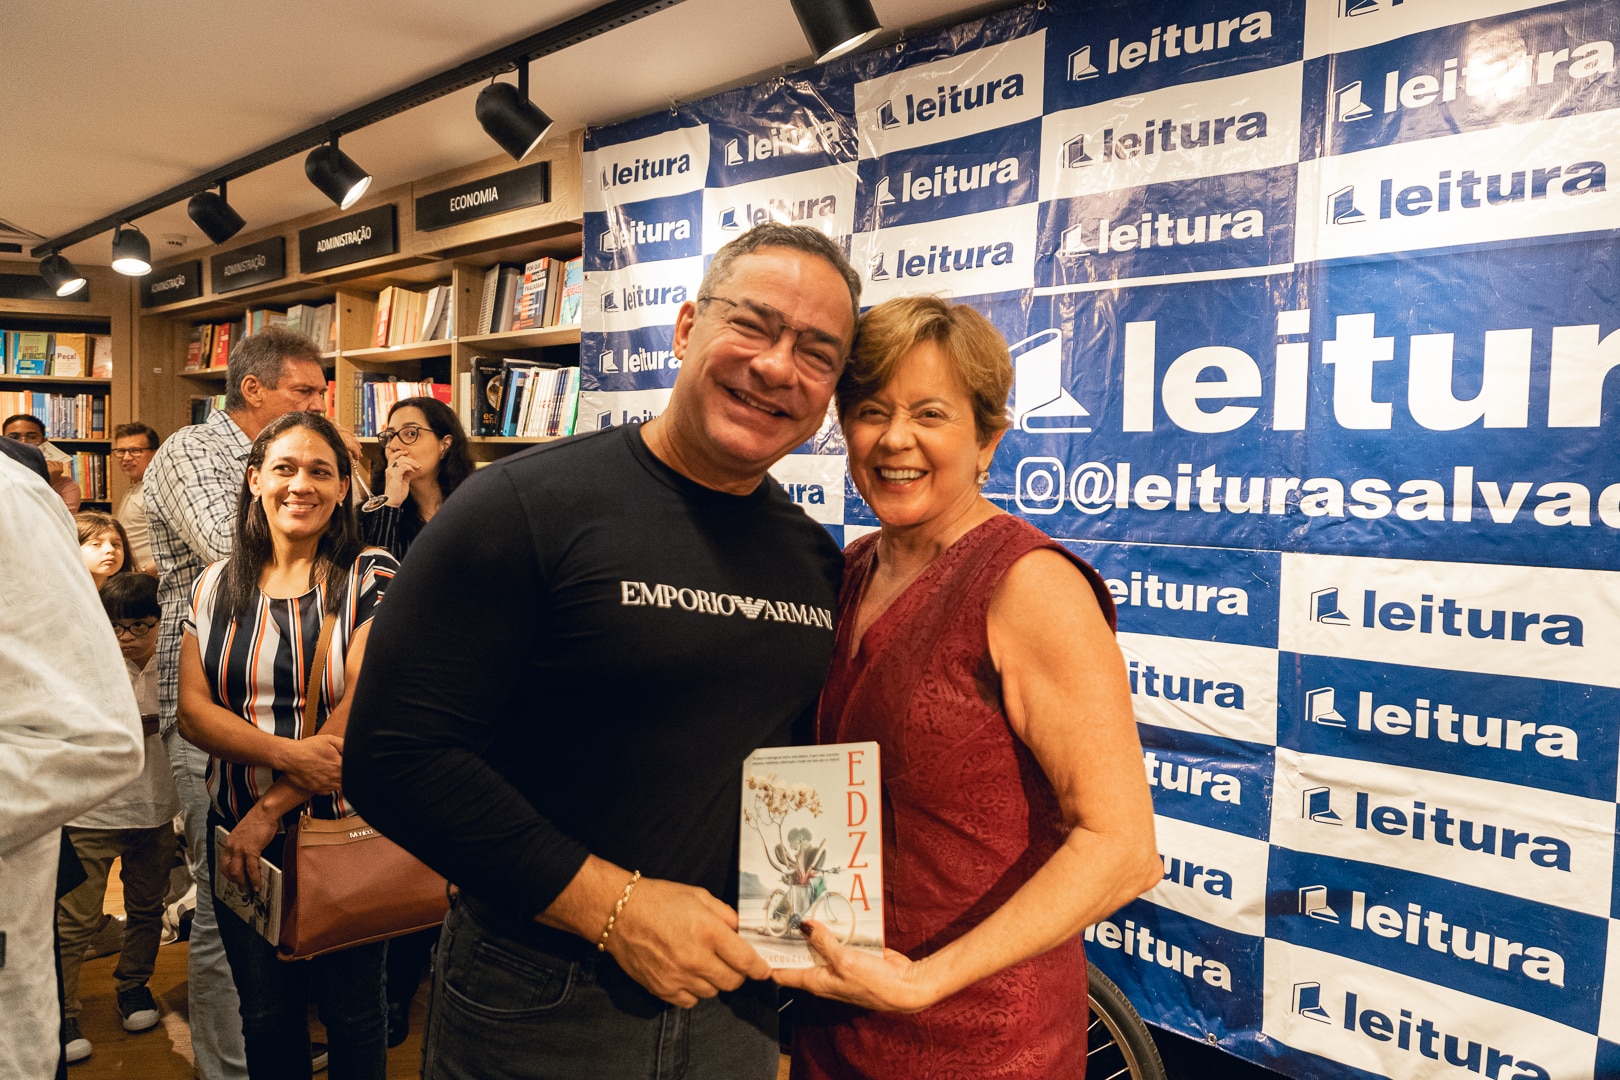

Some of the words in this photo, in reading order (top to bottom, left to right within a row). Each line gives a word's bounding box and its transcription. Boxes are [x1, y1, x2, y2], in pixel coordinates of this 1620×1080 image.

[1107, 10, 1273, 74] leitura
[905, 73, 1025, 125] leitura
[1103, 111, 1268, 163] leitura
[612, 153, 691, 187] leitura
[902, 156, 1020, 203] leitura
[1379, 160, 1607, 220] leitura
[450, 186, 499, 212] ECONOMIA
[316, 225, 372, 253] ADMINISTRAÇÃO
[1097, 208, 1265, 255] leitura
[223, 254, 267, 277] ADMINISTRAÇÃO
[896, 240, 1014, 279] leitura
[623, 285, 688, 312] leitura
[57, 352, 77, 361] Peça!
[622, 347, 682, 373] leitura
[620, 581, 736, 617] EMPORIO
[1100, 570, 1249, 617] eitura
[1362, 589, 1584, 648] leitura
[1128, 660, 1245, 711] itura
[1357, 690, 1579, 761] leitura
[847, 751, 871, 911] EDZA
[1355, 791, 1572, 873] leitura
[1083, 919, 1233, 993] leitura
[1350, 889, 1566, 989] leitura
